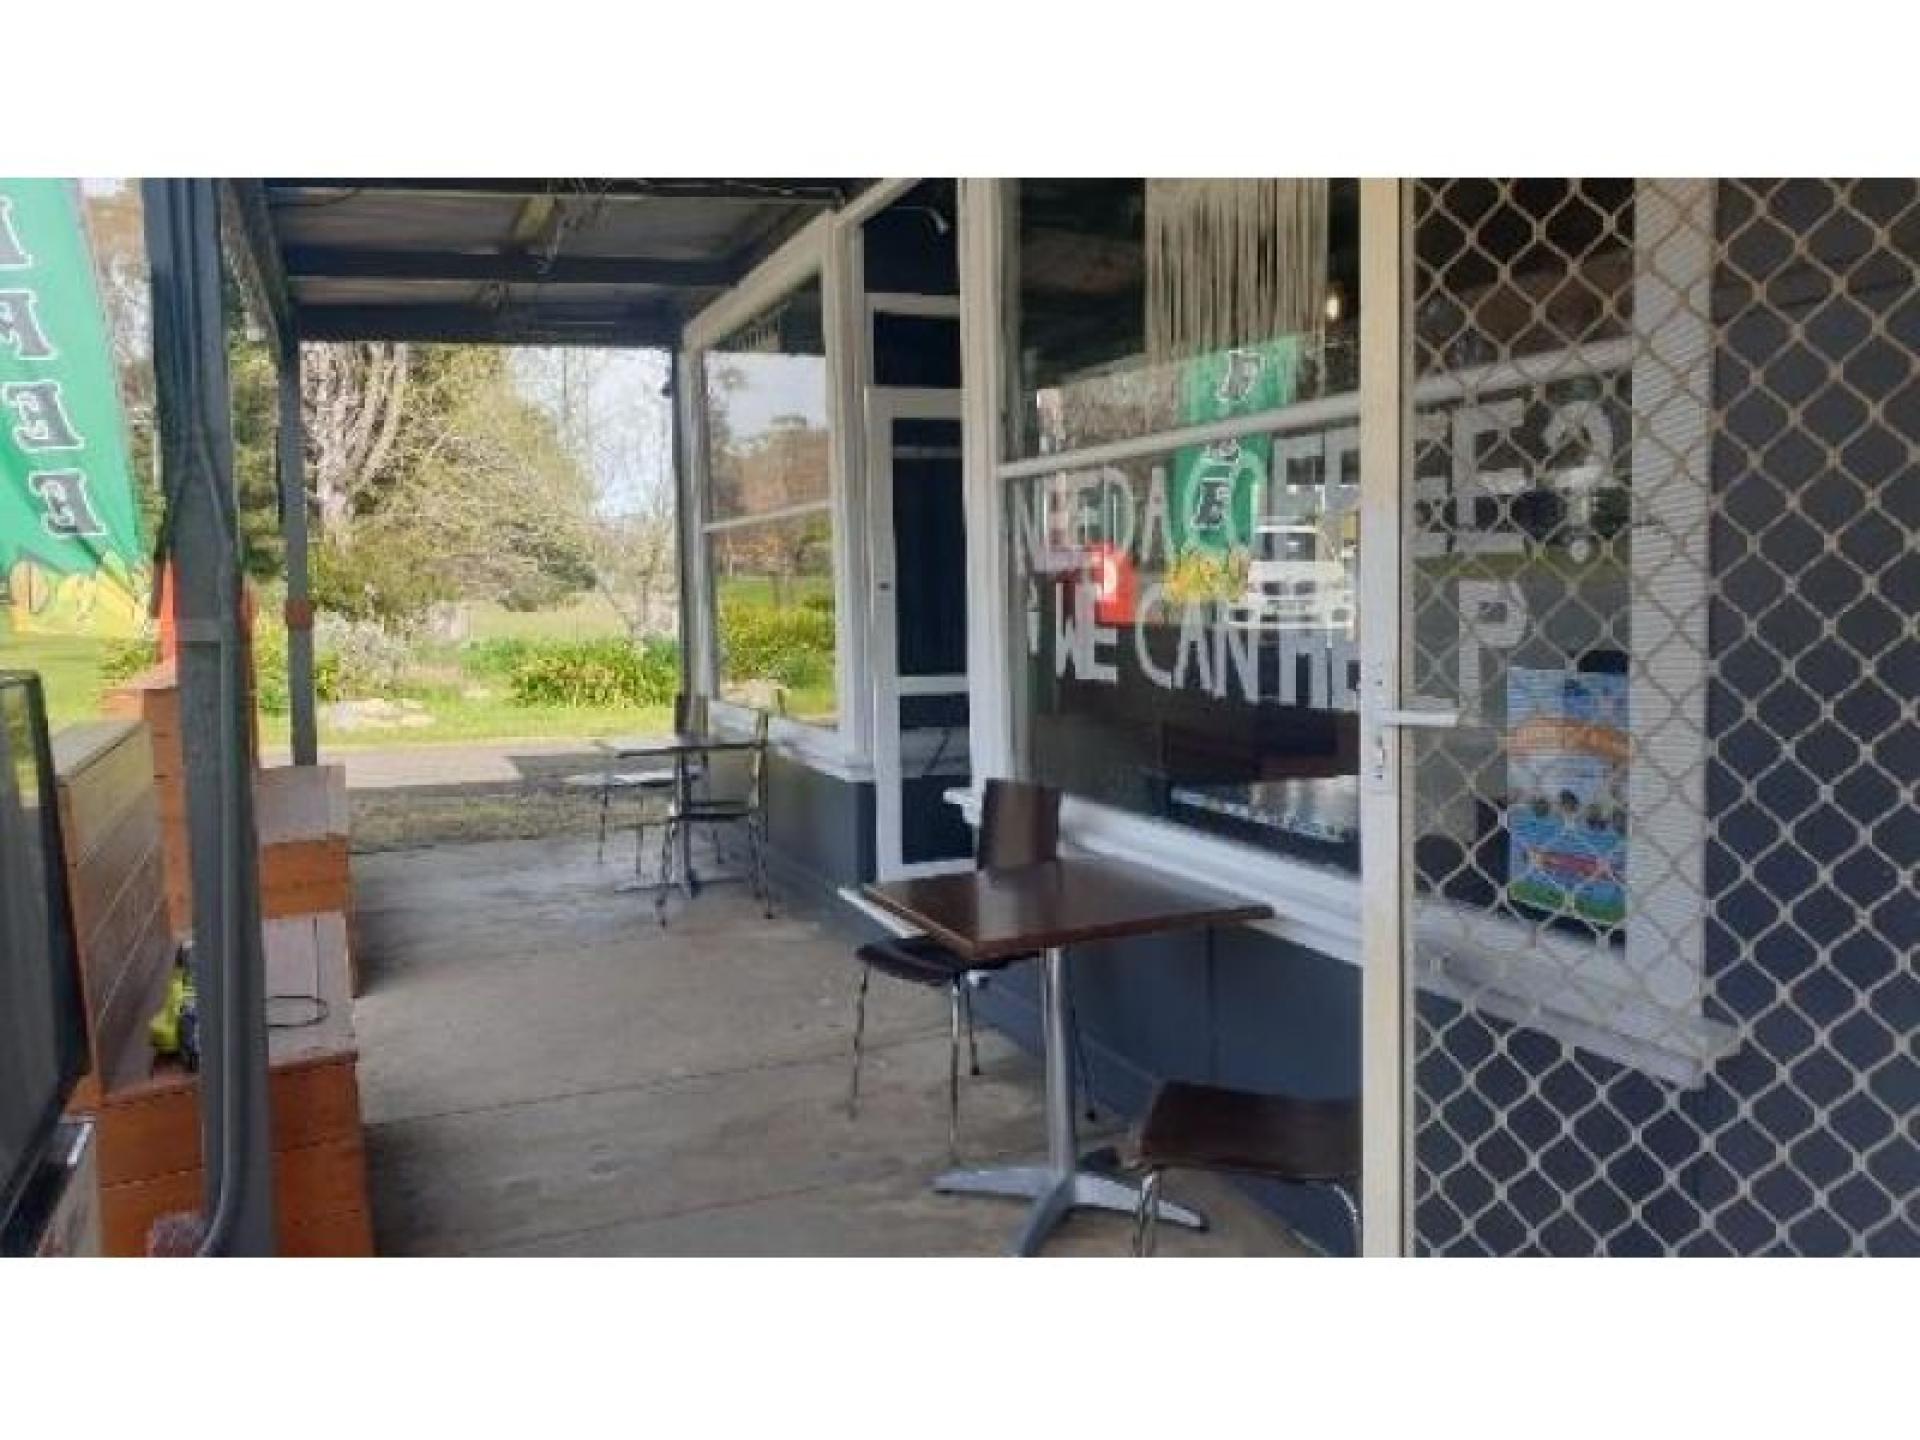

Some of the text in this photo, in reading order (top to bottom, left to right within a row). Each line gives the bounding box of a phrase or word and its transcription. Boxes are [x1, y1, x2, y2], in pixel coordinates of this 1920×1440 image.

[1141, 468, 1175, 566] A
[1055, 582, 1117, 684] WE
[1134, 582, 1259, 704] CAN
[1279, 580, 1529, 719] HEP
